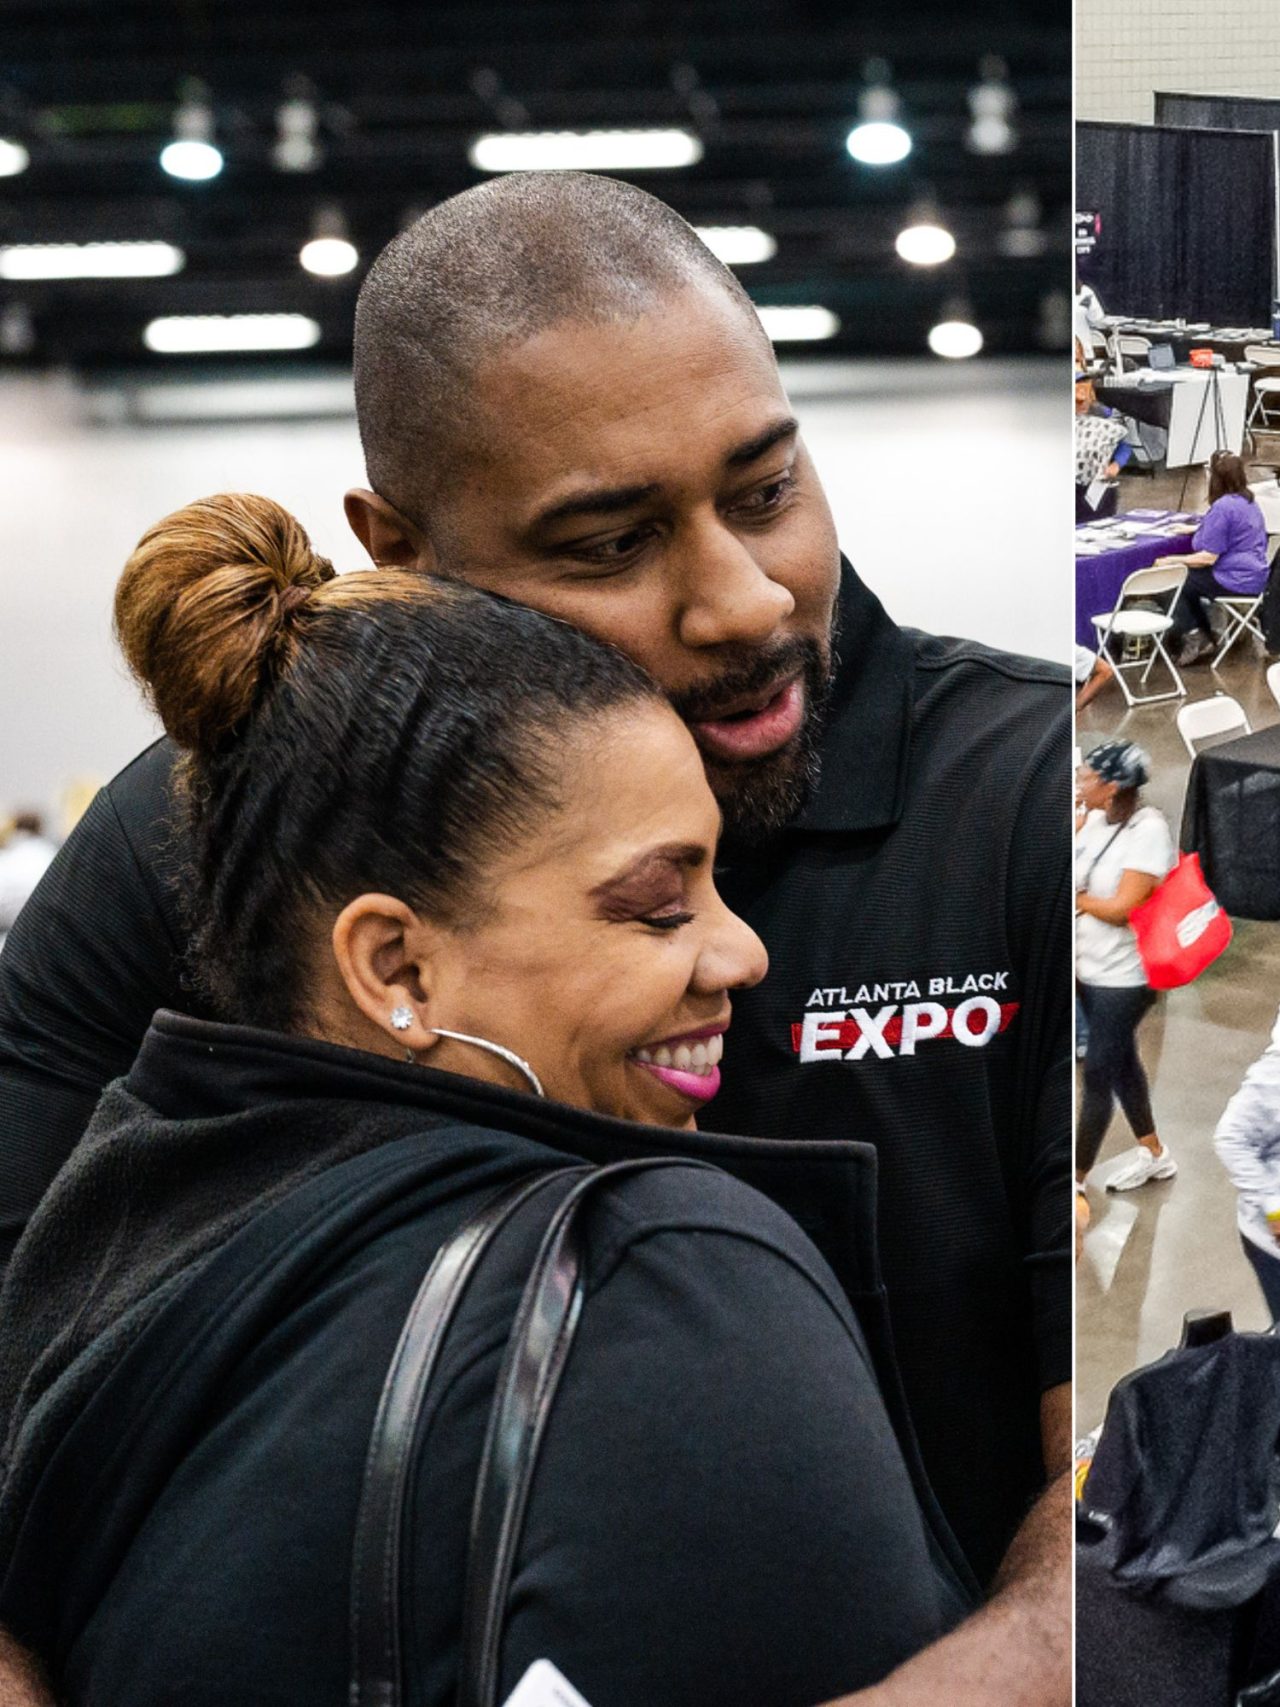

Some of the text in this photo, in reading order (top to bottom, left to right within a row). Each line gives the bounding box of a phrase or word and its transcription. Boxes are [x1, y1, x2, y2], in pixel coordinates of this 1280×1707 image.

[805, 971, 1009, 1007] ATLANTA BLACK
[800, 996, 1001, 1063] EXPO
